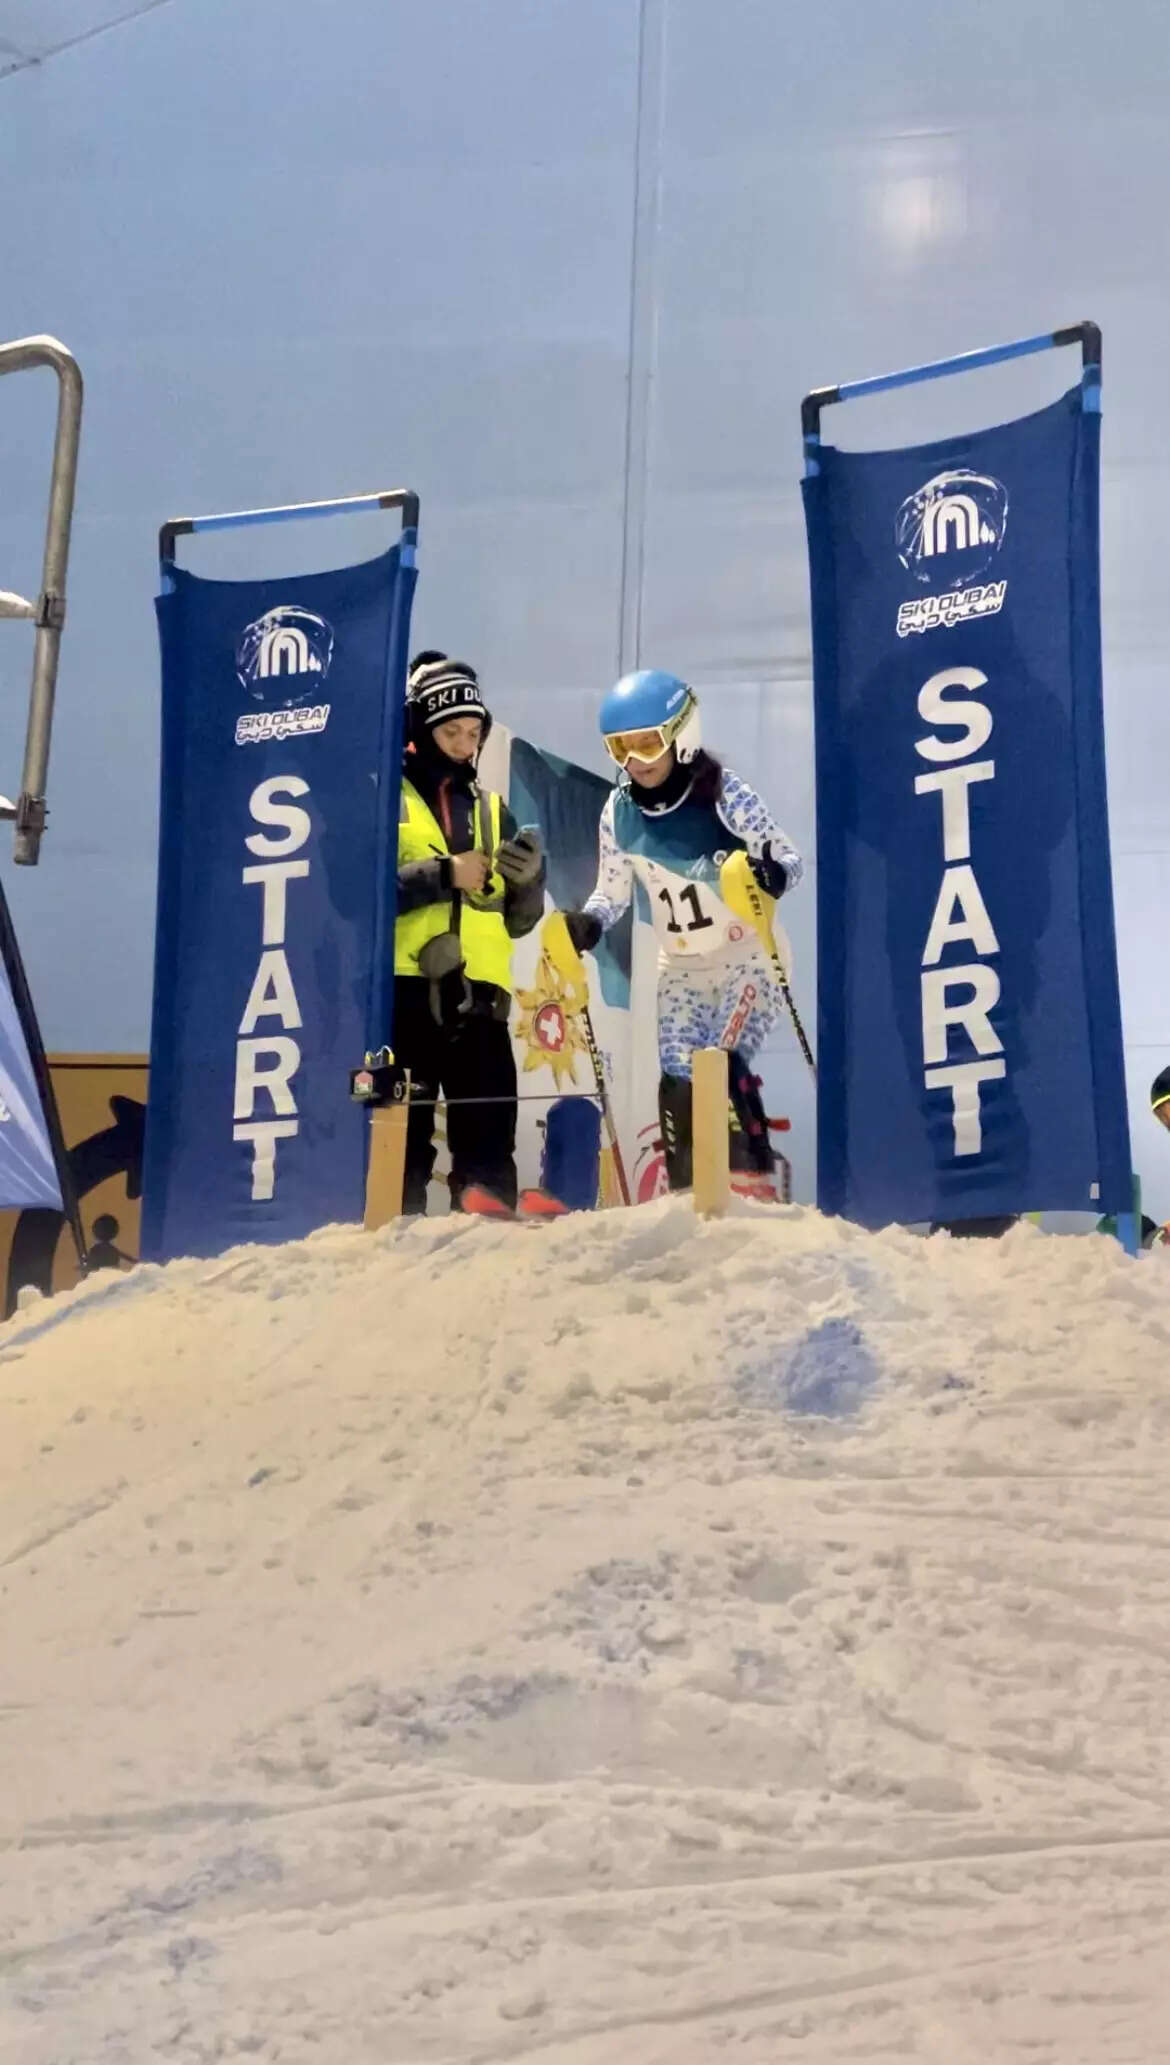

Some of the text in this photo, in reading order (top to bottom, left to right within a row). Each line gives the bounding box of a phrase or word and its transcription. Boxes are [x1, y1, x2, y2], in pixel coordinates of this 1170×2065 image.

[900, 582, 1005, 619] SKI DUBAI
[898, 603, 1001, 636] سكي دبي
[238, 706, 328, 730] SKI DUBAI
[427, 688, 457, 712] SKI
[658, 883, 714, 933] 11
[914, 666, 1006, 1156] START
[233, 775, 311, 1200] START
